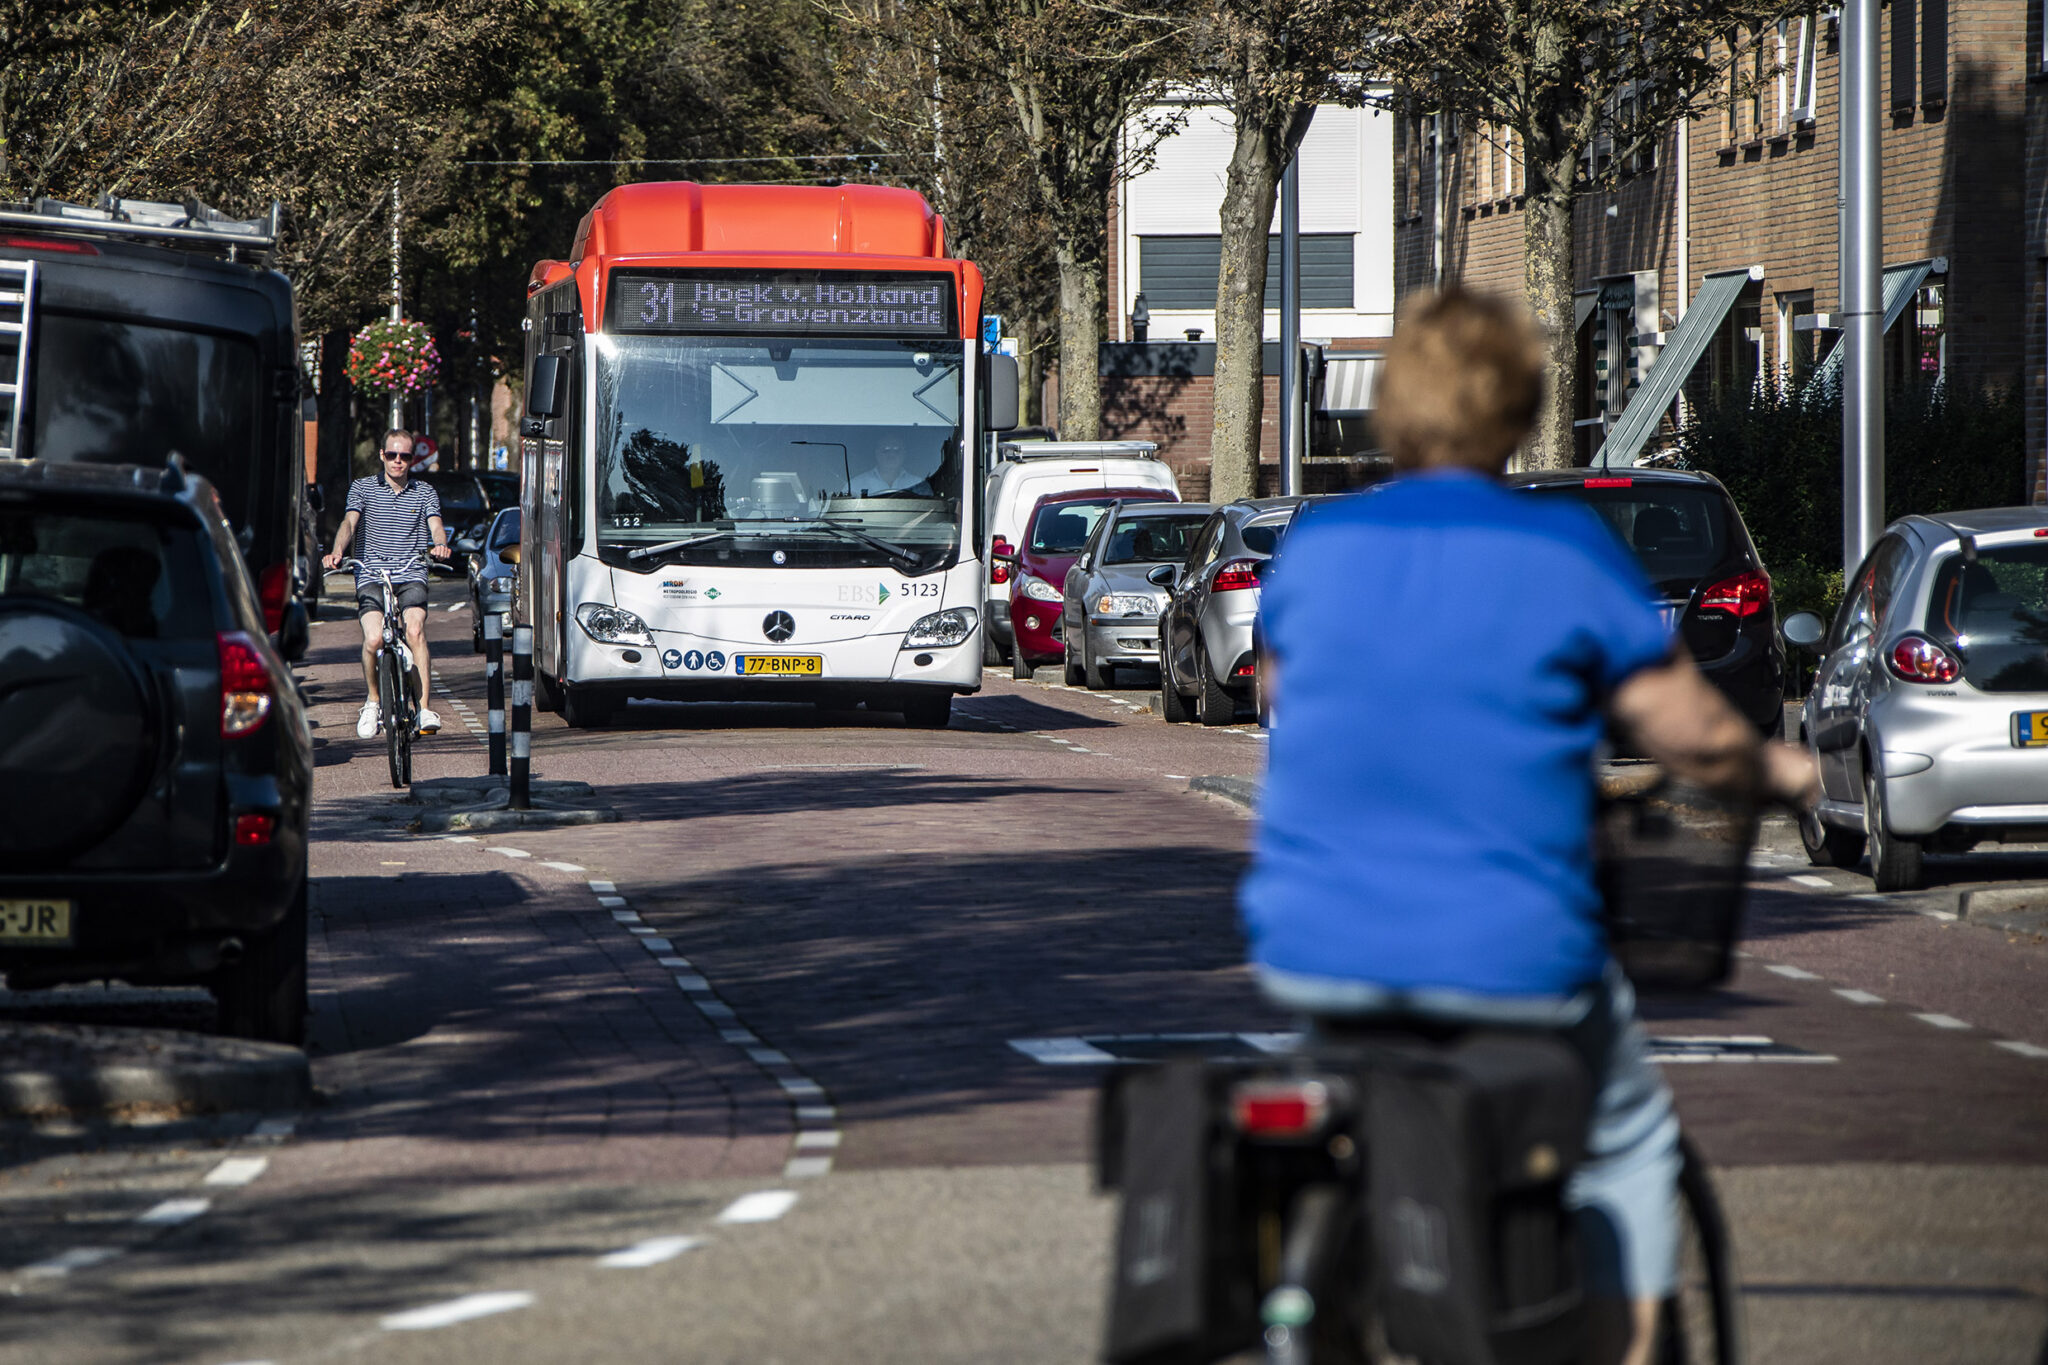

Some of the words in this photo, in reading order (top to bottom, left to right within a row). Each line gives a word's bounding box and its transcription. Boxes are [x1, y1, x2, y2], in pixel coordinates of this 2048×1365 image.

[640, 282, 674, 323] 31
[695, 283, 773, 303] Hoek
[782, 288, 807, 303] v.
[816, 284, 938, 305] Holland
[837, 585, 875, 602] EBS
[901, 583, 938, 597] 5123
[748, 658, 815, 671] 77-BNP-8
